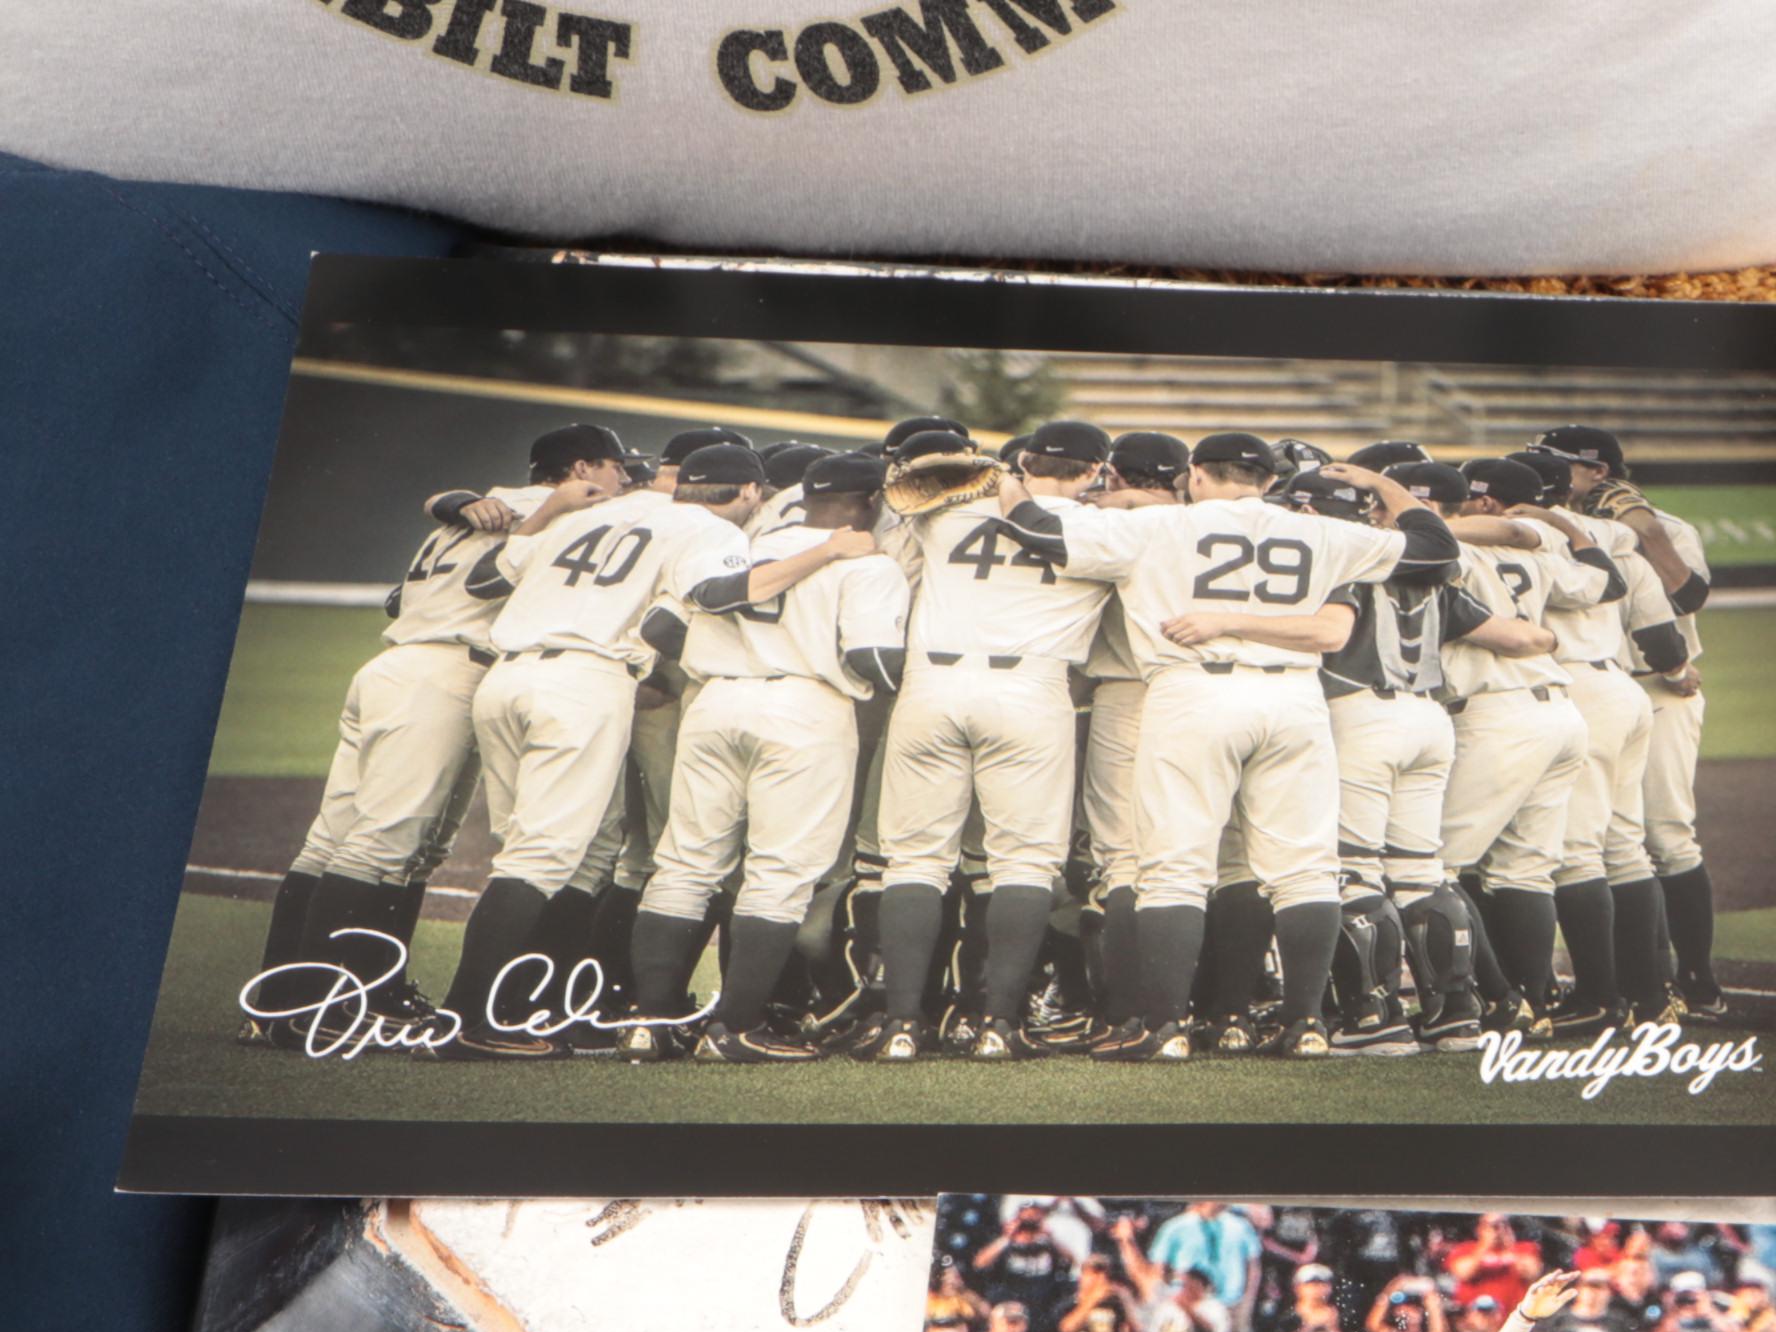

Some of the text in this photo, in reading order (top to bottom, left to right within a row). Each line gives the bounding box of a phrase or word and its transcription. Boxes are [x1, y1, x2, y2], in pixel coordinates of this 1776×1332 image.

[320, 0, 632, 99] BILT
[552, 524, 652, 587] 40
[1192, 533, 1313, 605] 29
[1477, 1022, 1763, 1100] VandyBoys
